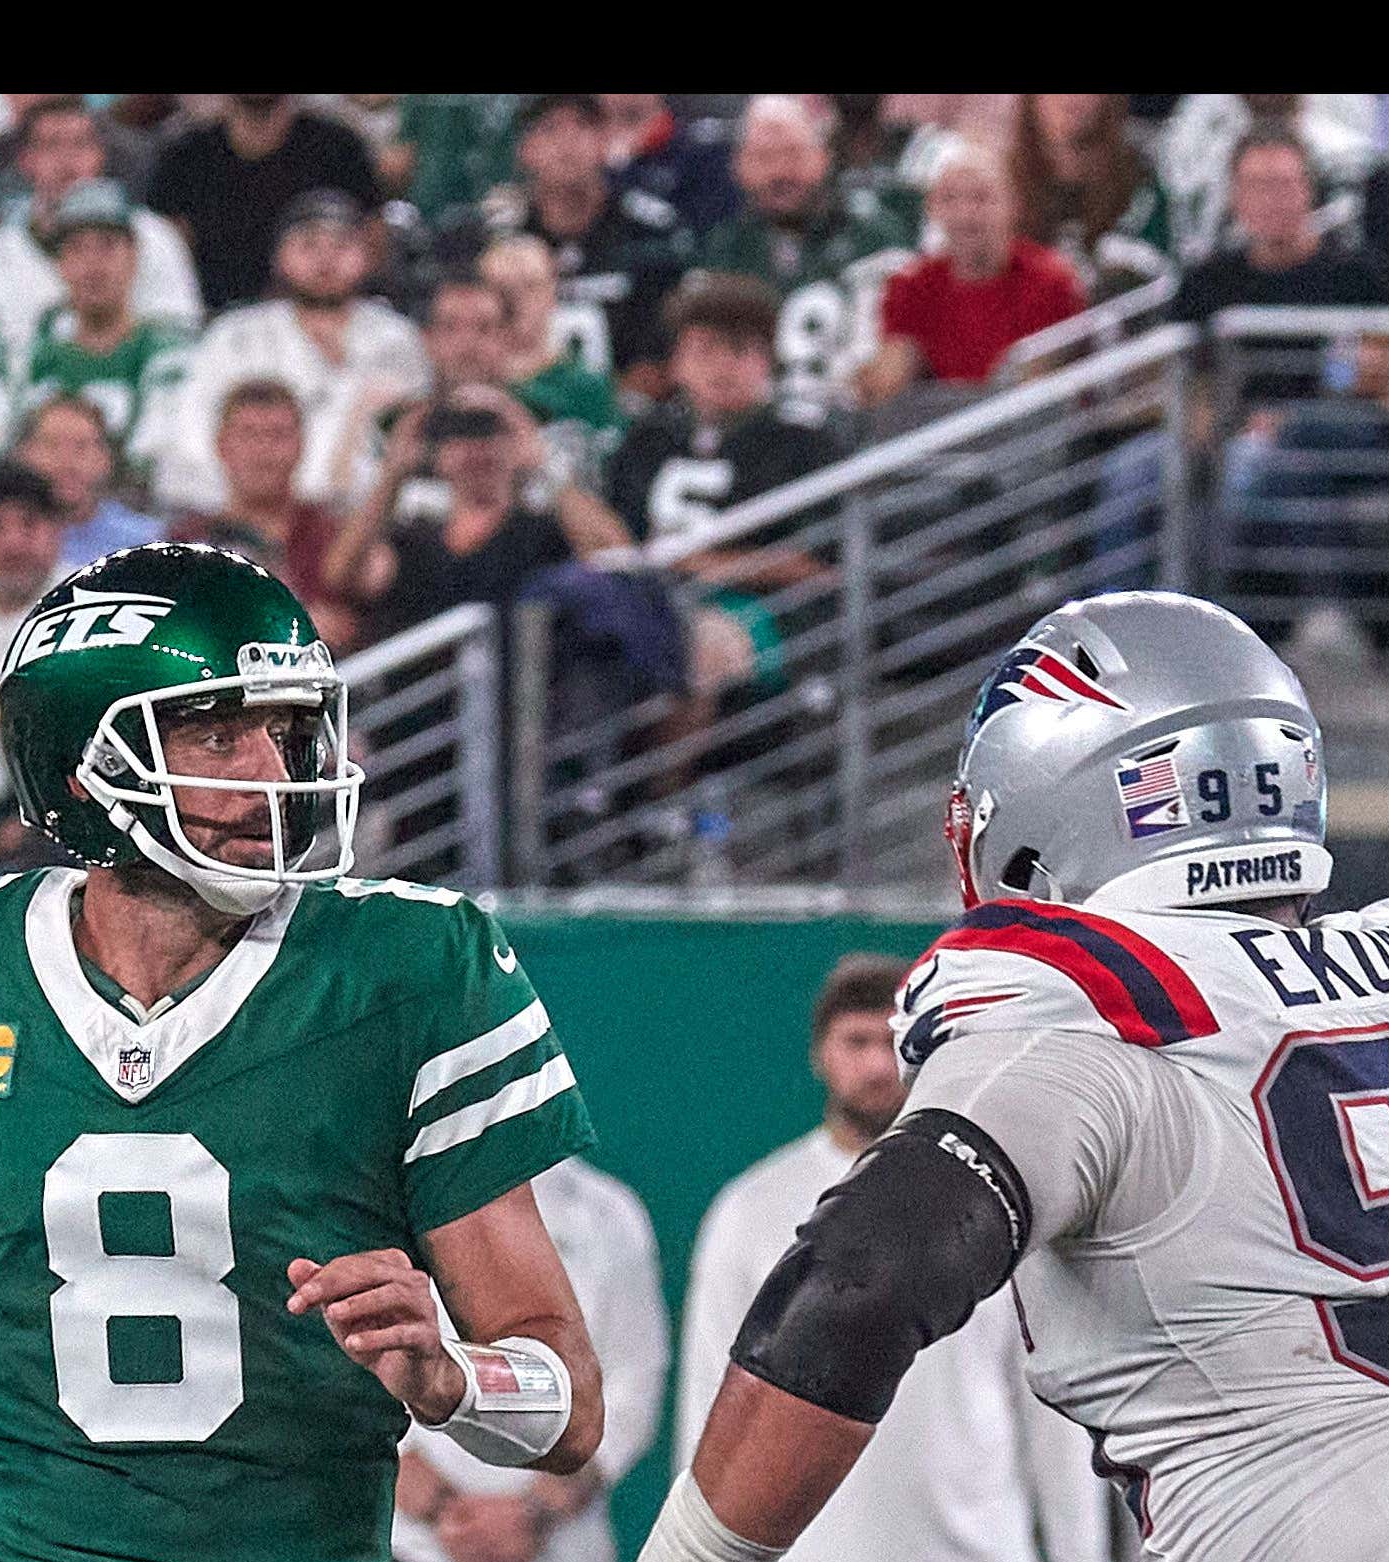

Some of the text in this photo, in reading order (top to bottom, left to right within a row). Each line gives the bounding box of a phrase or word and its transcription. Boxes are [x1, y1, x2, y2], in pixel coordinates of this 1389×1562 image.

[0, 588, 177, 682] JETS
[1187, 850, 1302, 896] PATRIOTS
[119, 1063, 147, 1082] NFL
[43, 1133, 244, 1443] 8
